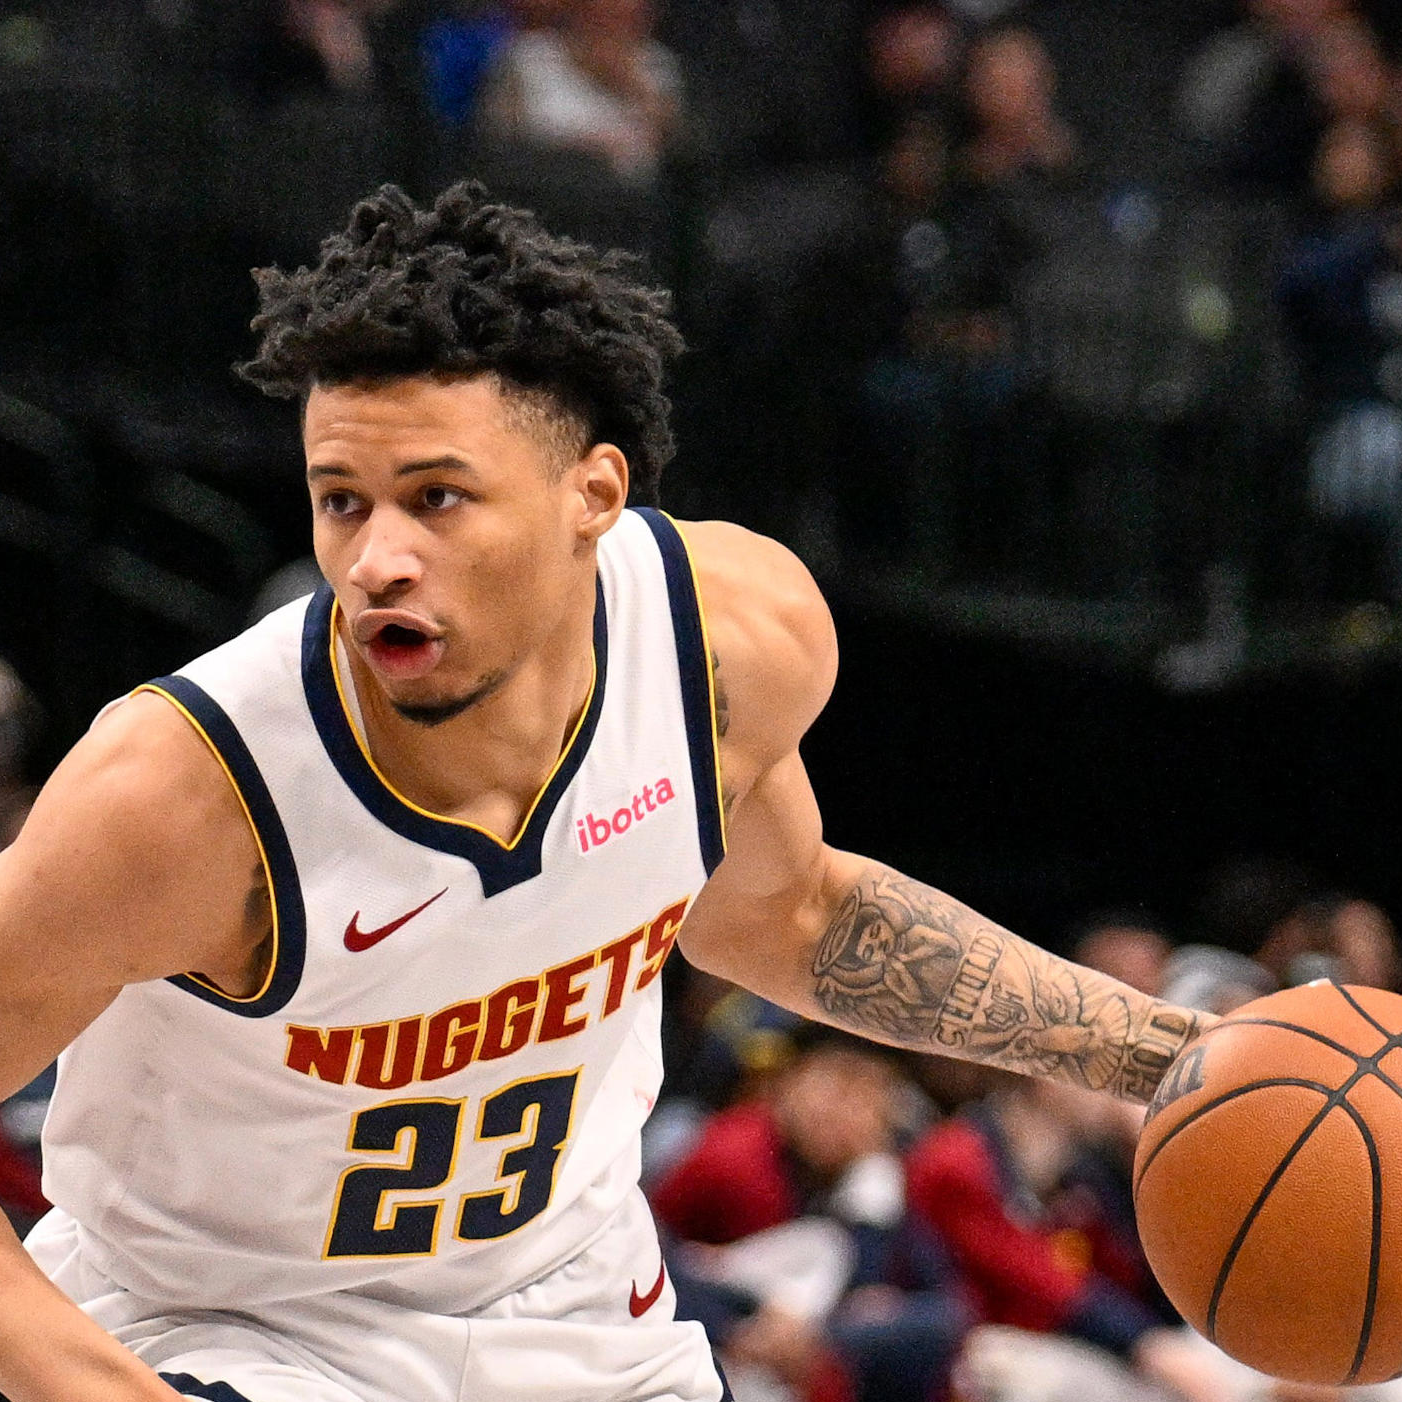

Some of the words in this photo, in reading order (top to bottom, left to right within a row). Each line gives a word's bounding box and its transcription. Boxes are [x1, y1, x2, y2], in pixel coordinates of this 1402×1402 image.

[576, 775, 676, 853] ibotta
[285, 894, 692, 1091] NUGGETS
[322, 1064, 586, 1261] 23
